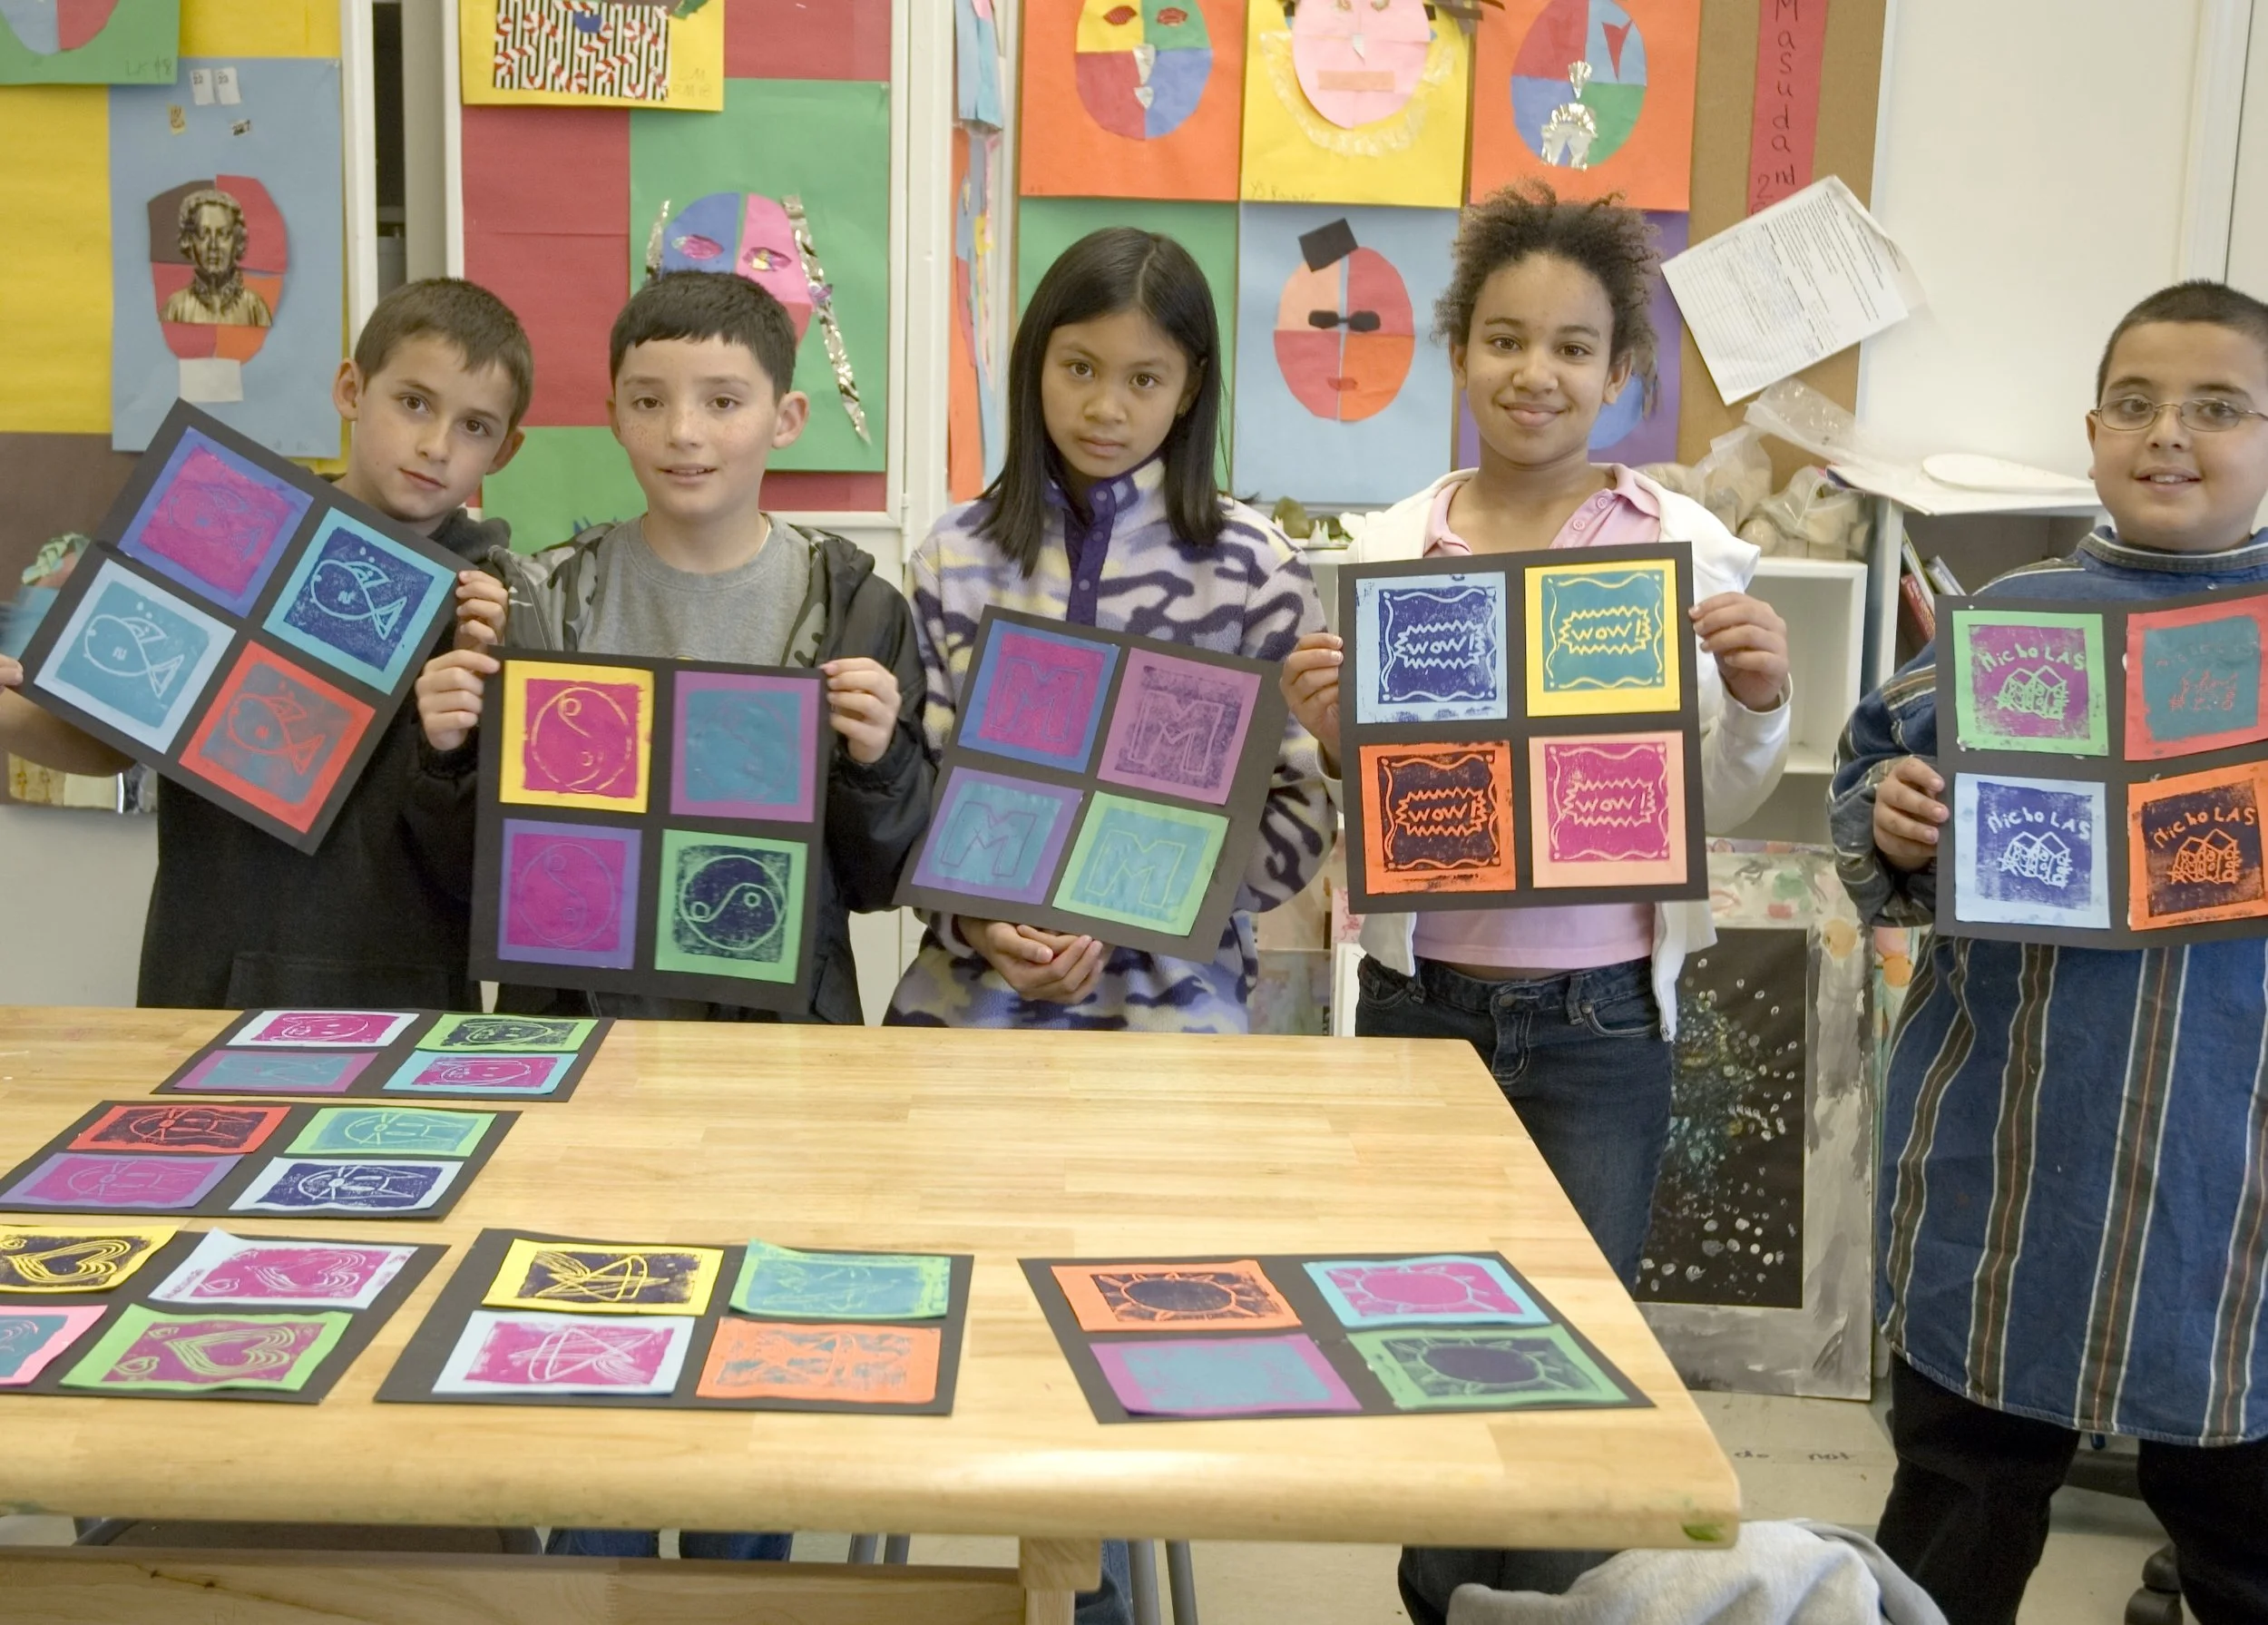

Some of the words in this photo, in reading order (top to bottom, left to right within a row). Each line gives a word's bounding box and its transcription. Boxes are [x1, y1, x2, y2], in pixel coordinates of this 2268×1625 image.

[1772, 0, 1798, 153] Masuda
[1127, 690, 1226, 776] M
[940, 801, 1040, 877] M
[1085, 828, 1188, 909] M
